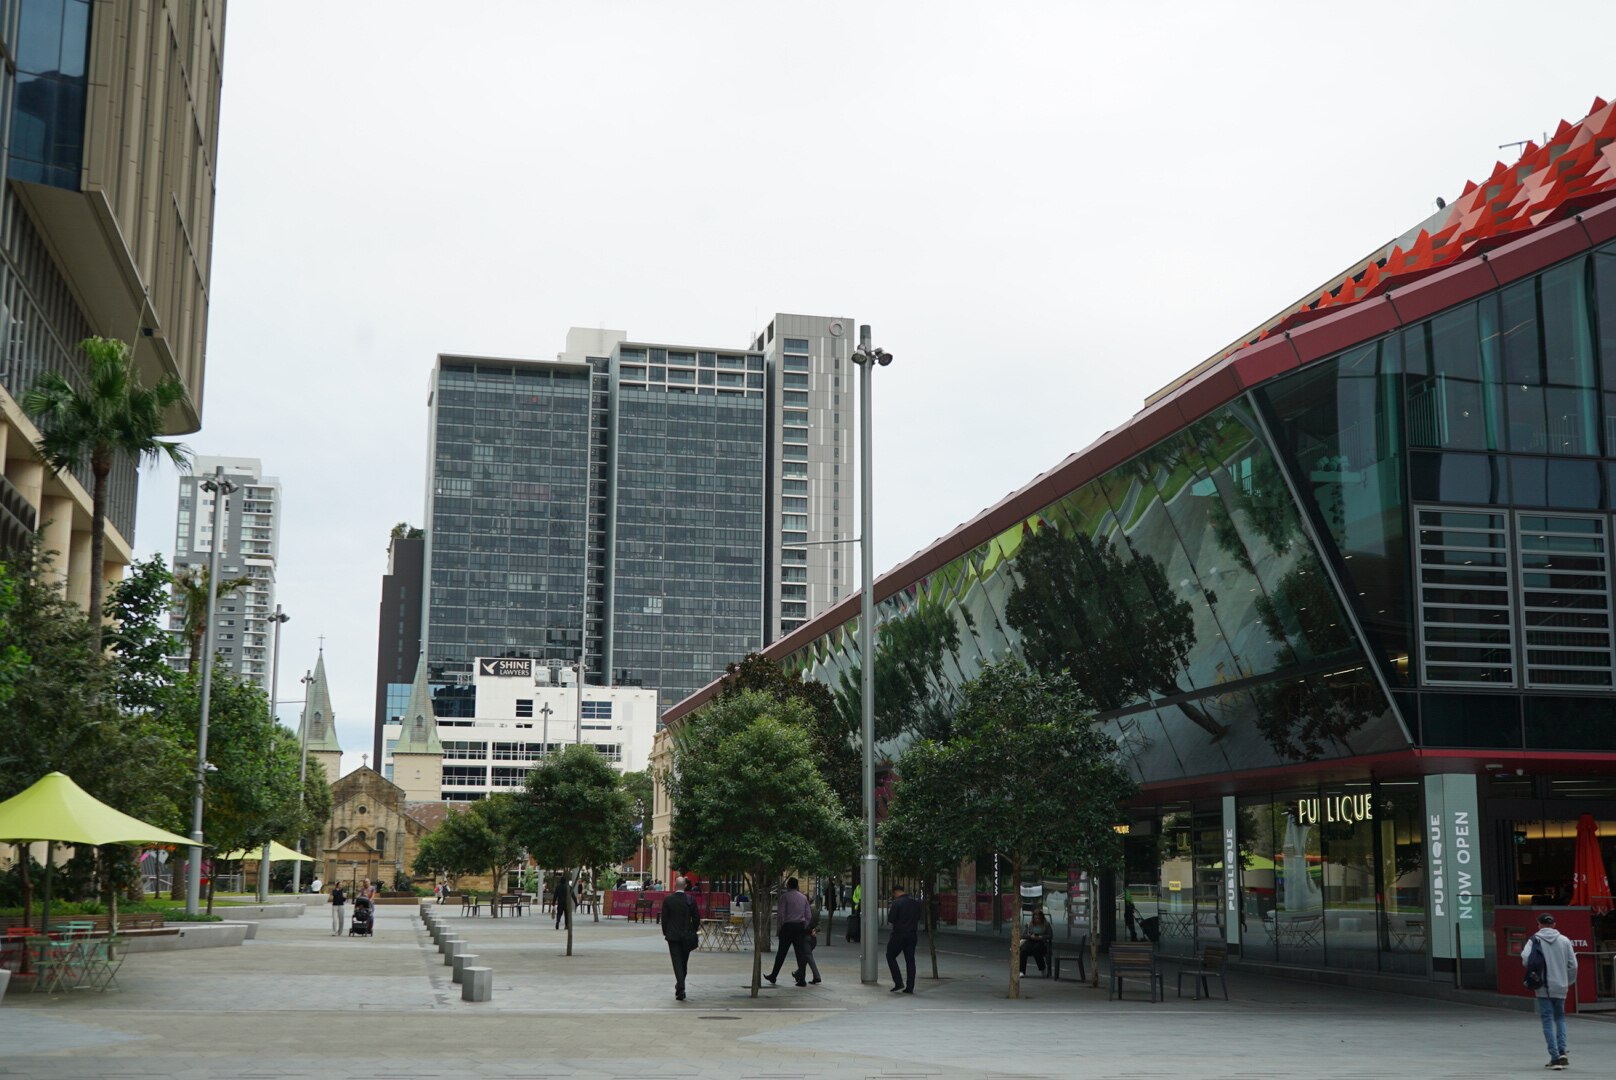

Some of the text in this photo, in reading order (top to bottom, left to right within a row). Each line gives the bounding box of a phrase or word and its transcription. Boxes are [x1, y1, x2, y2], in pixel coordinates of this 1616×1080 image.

[499, 660, 530, 670] SHINE
[1299, 794, 1373, 824] PULIQUE
[1226, 828, 1236, 911] PUBLIQUE
[1430, 814, 1445, 917] PUBLIQUE
[1454, 811, 1473, 919] NOW OPEN
